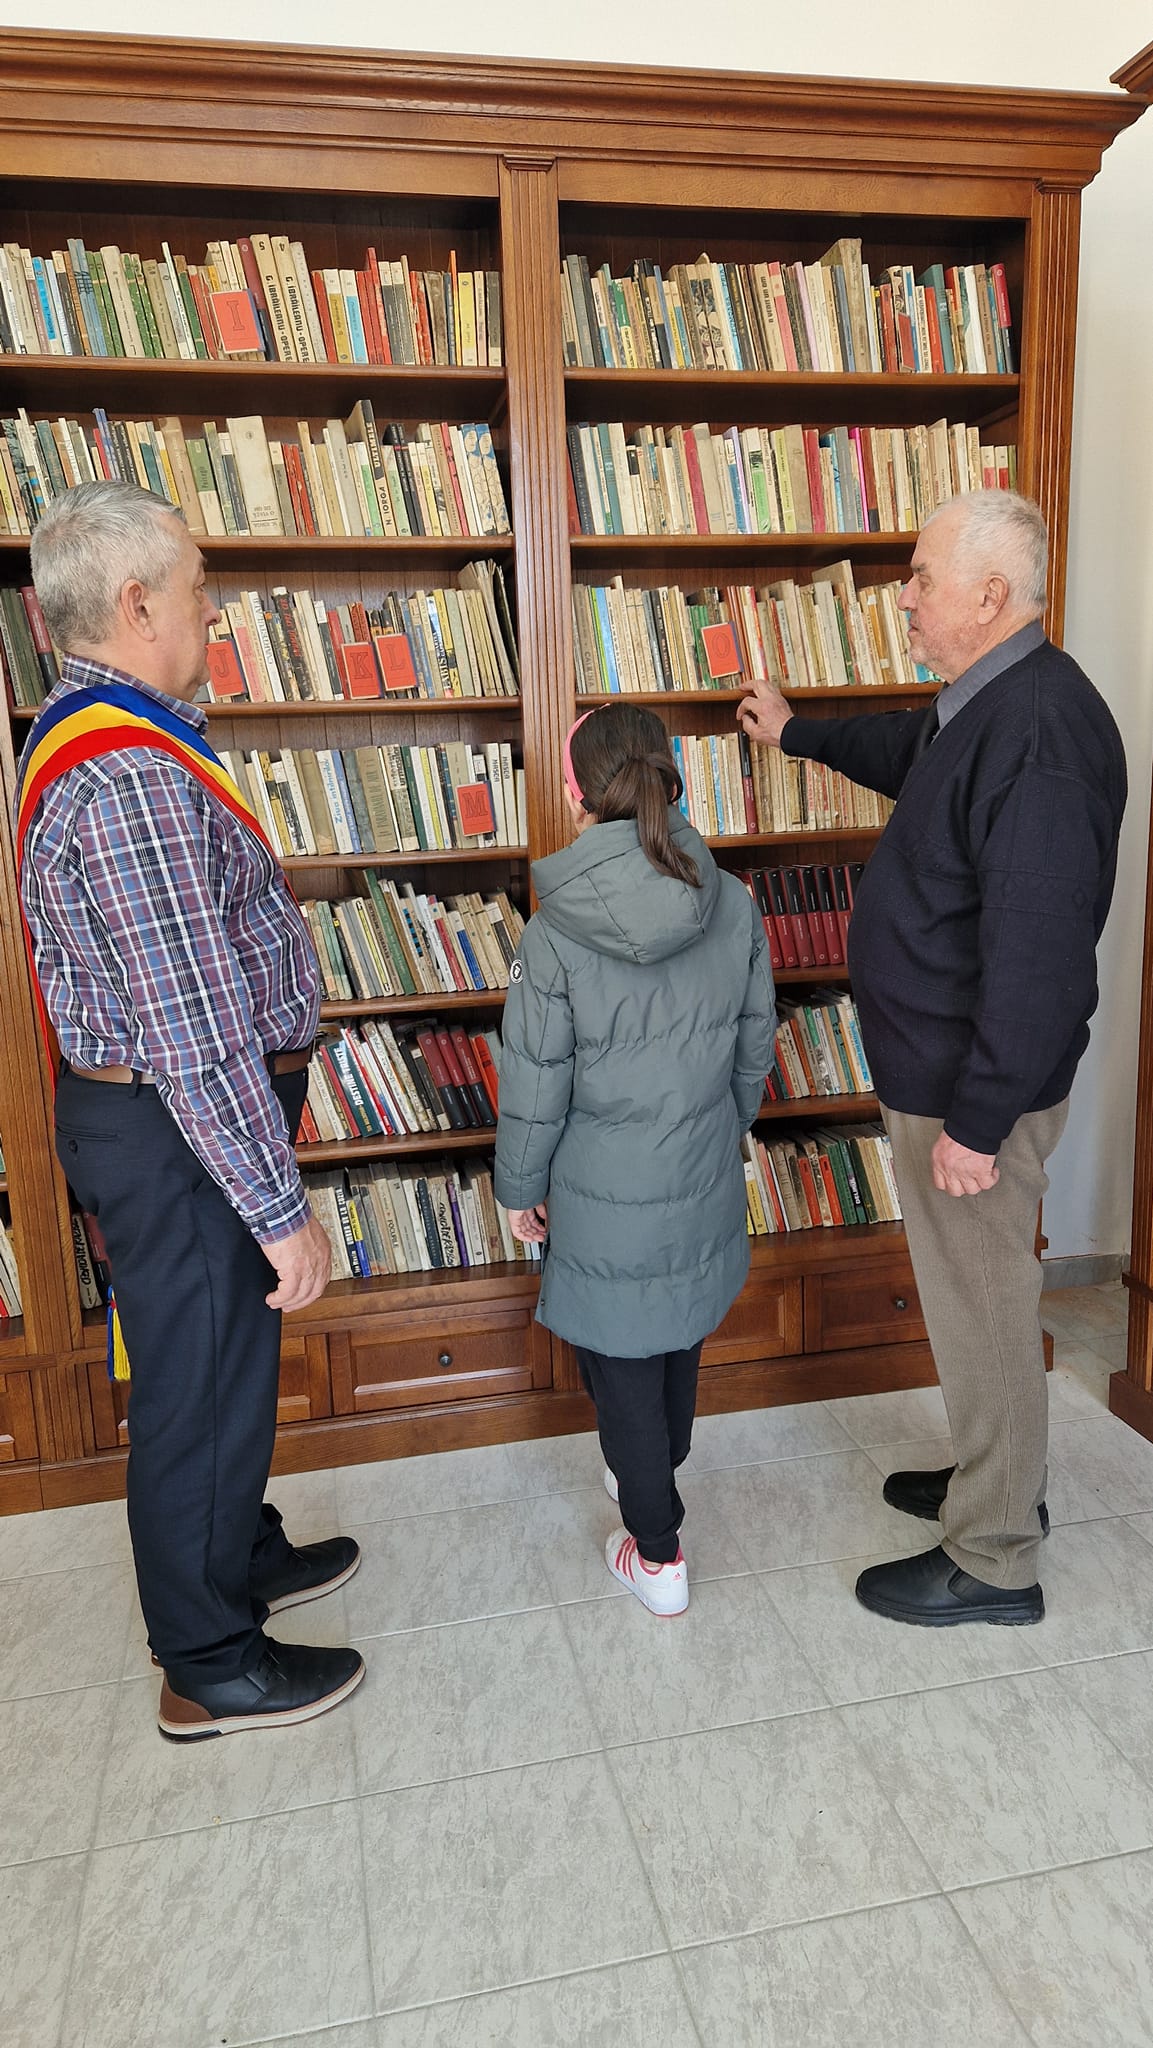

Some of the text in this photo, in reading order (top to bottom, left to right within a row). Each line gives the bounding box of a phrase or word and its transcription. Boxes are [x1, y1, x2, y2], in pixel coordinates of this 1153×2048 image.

[280, 335, 292, 361] OPERE
[298, 335, 309, 363] OPERE
[378, 486, 389, 513] IORGA
[334, 1045, 363, 1106] DESTINE TRISTE
